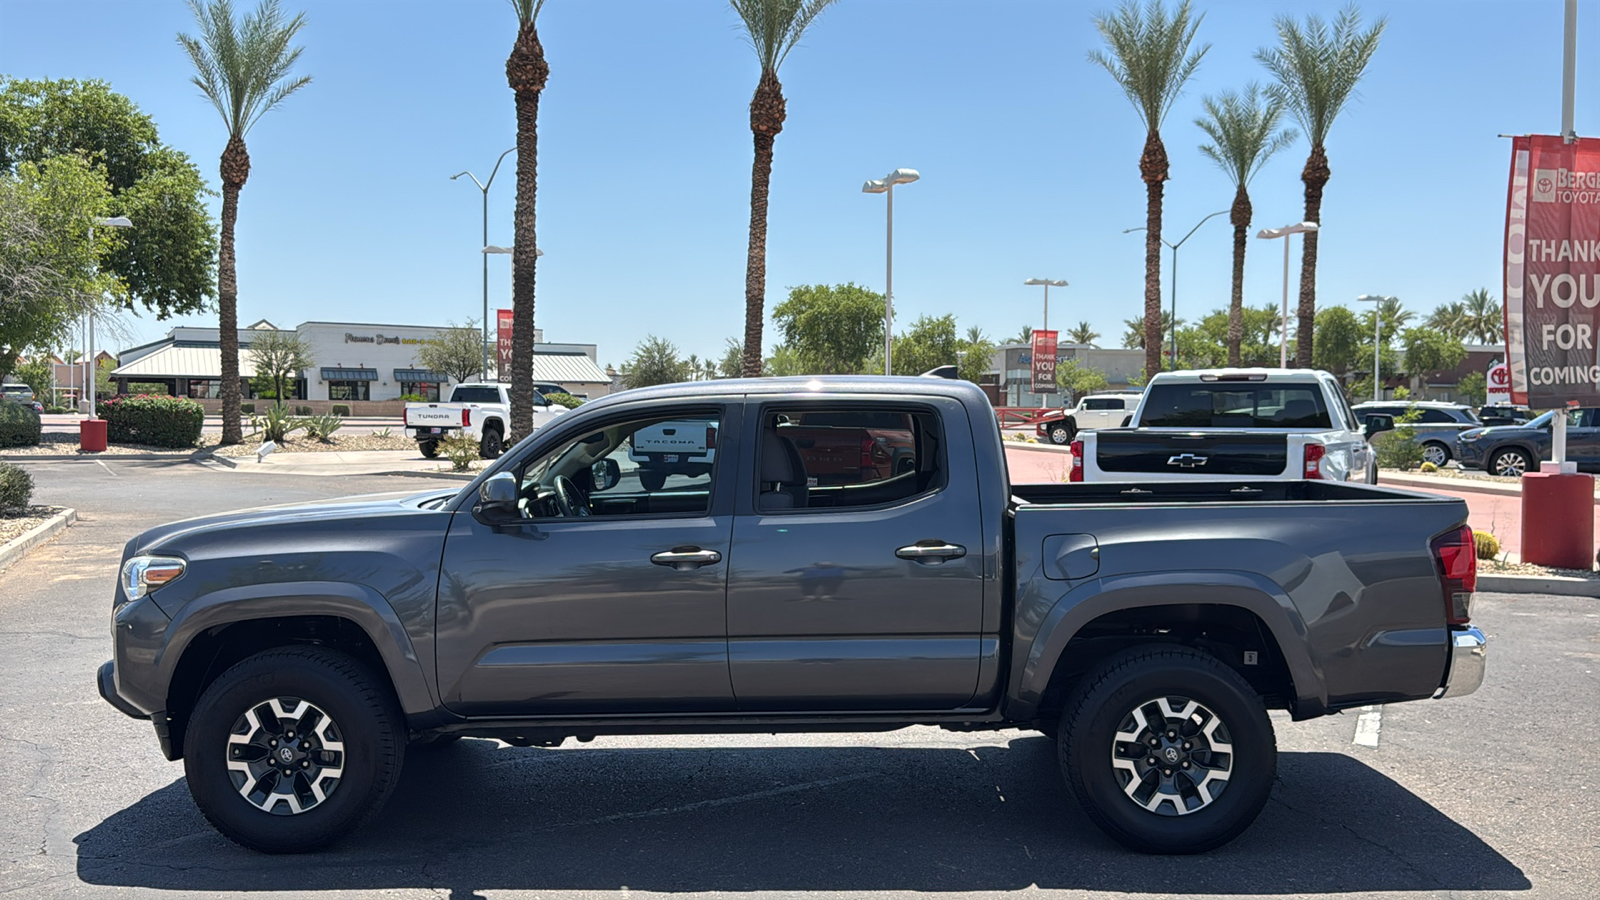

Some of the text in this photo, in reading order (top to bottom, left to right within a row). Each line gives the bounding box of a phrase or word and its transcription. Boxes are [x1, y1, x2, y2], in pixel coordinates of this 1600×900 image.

[1529, 239, 1600, 262] THANK
[1529, 273, 1600, 309] YOU
[1542, 323, 1593, 351] FOR
[500, 349, 513, 360] YO
[1036, 362, 1055, 371] YOU
[1529, 365, 1600, 386] COMING
